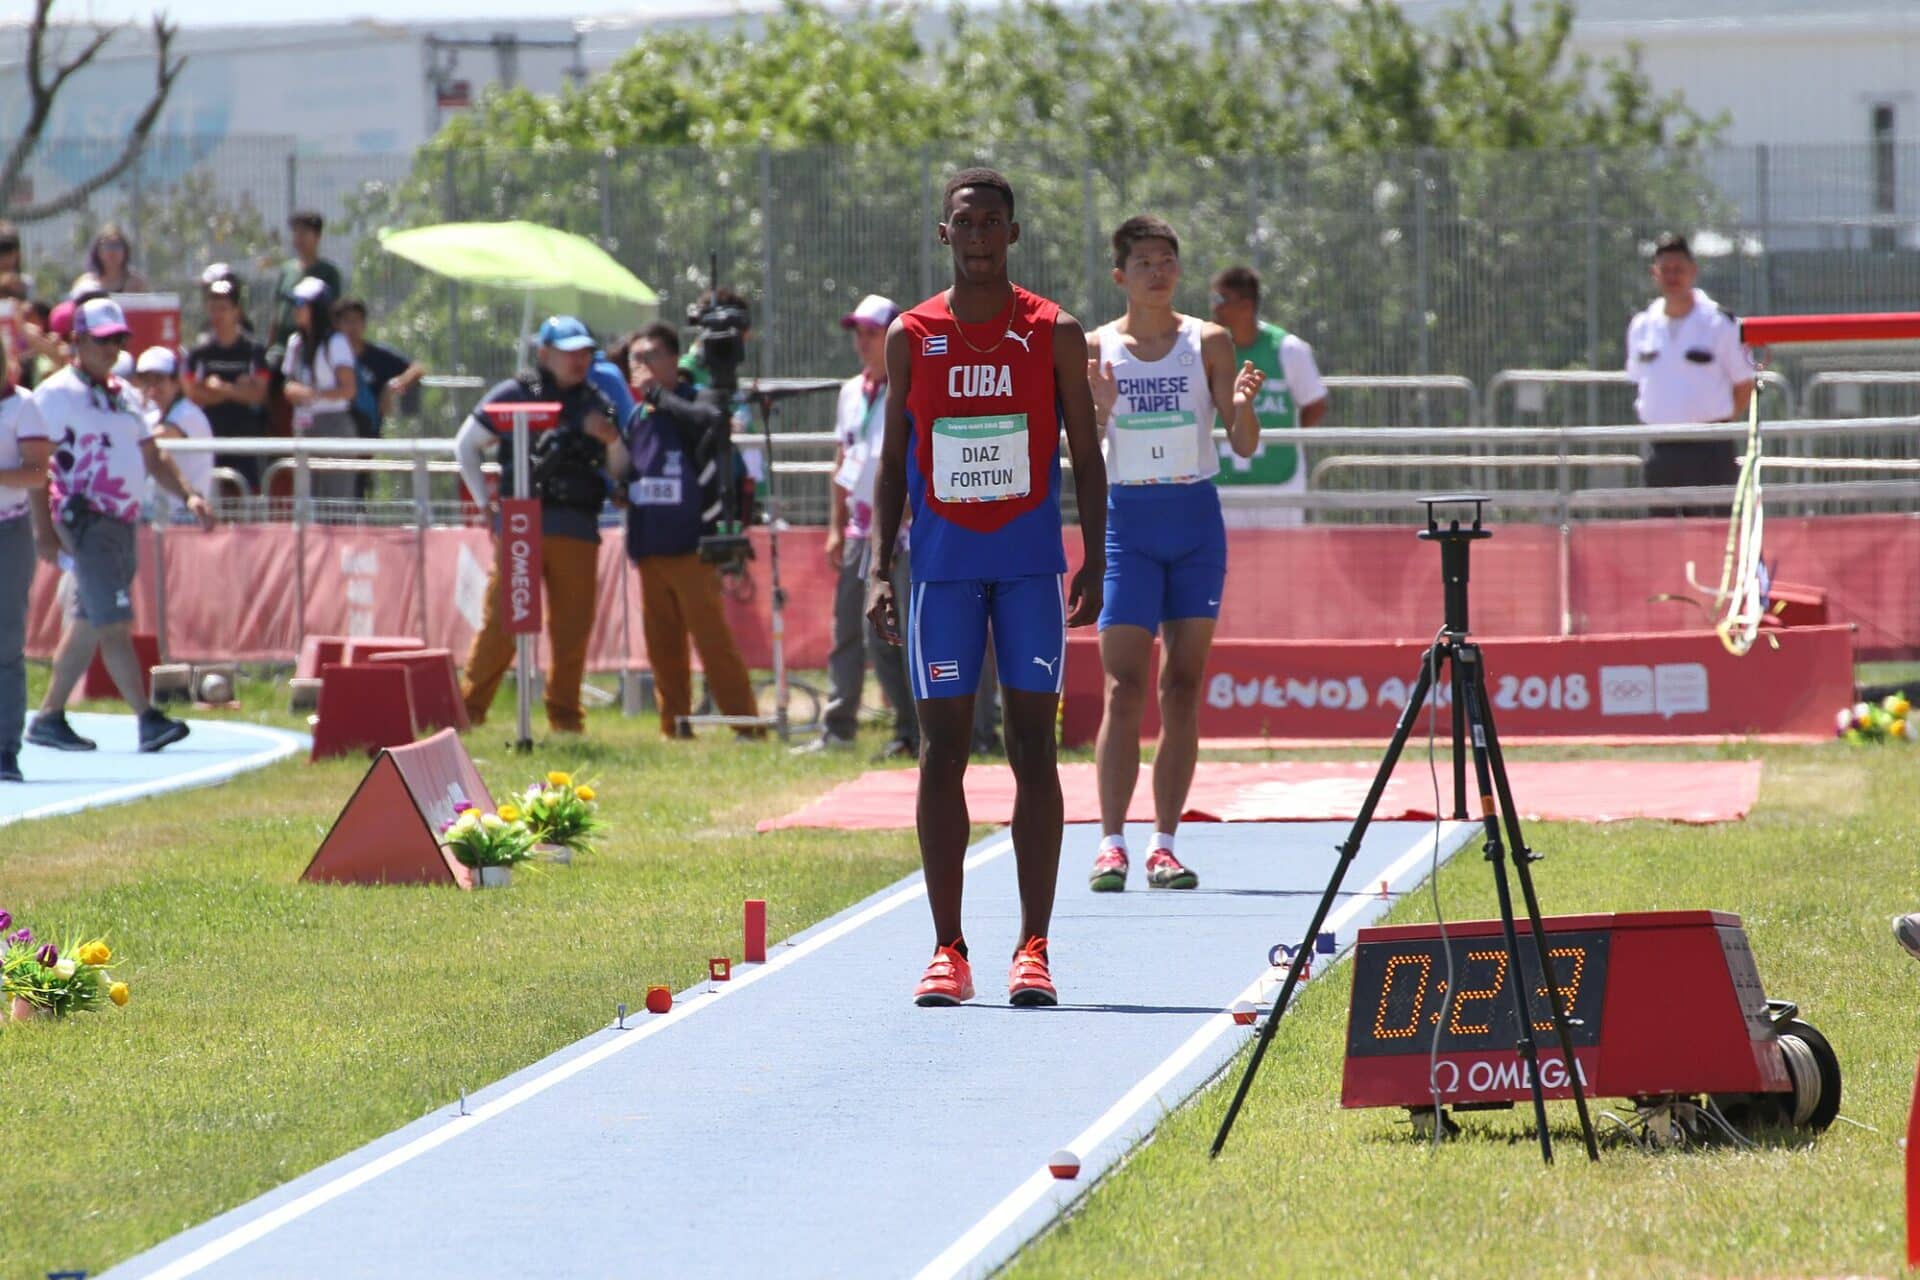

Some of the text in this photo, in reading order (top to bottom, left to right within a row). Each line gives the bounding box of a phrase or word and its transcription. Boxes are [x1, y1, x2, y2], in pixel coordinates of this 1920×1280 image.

[948, 364, 1013, 398] CUBA
[1117, 376, 1189, 395] CHINESE
[1127, 395, 1180, 413] TAIPEI
[962, 445, 1001, 463] DIAZ
[1151, 446, 1165, 459] LI
[950, 468, 1013, 488] FORTUN
[511, 540, 530, 623] OMEGA
[1206, 672, 1369, 710] BUENOS
[1494, 673, 1590, 710] 2018
[1373, 948, 1587, 1039] 0:23
[1468, 1057, 1588, 1092] OMEGA
